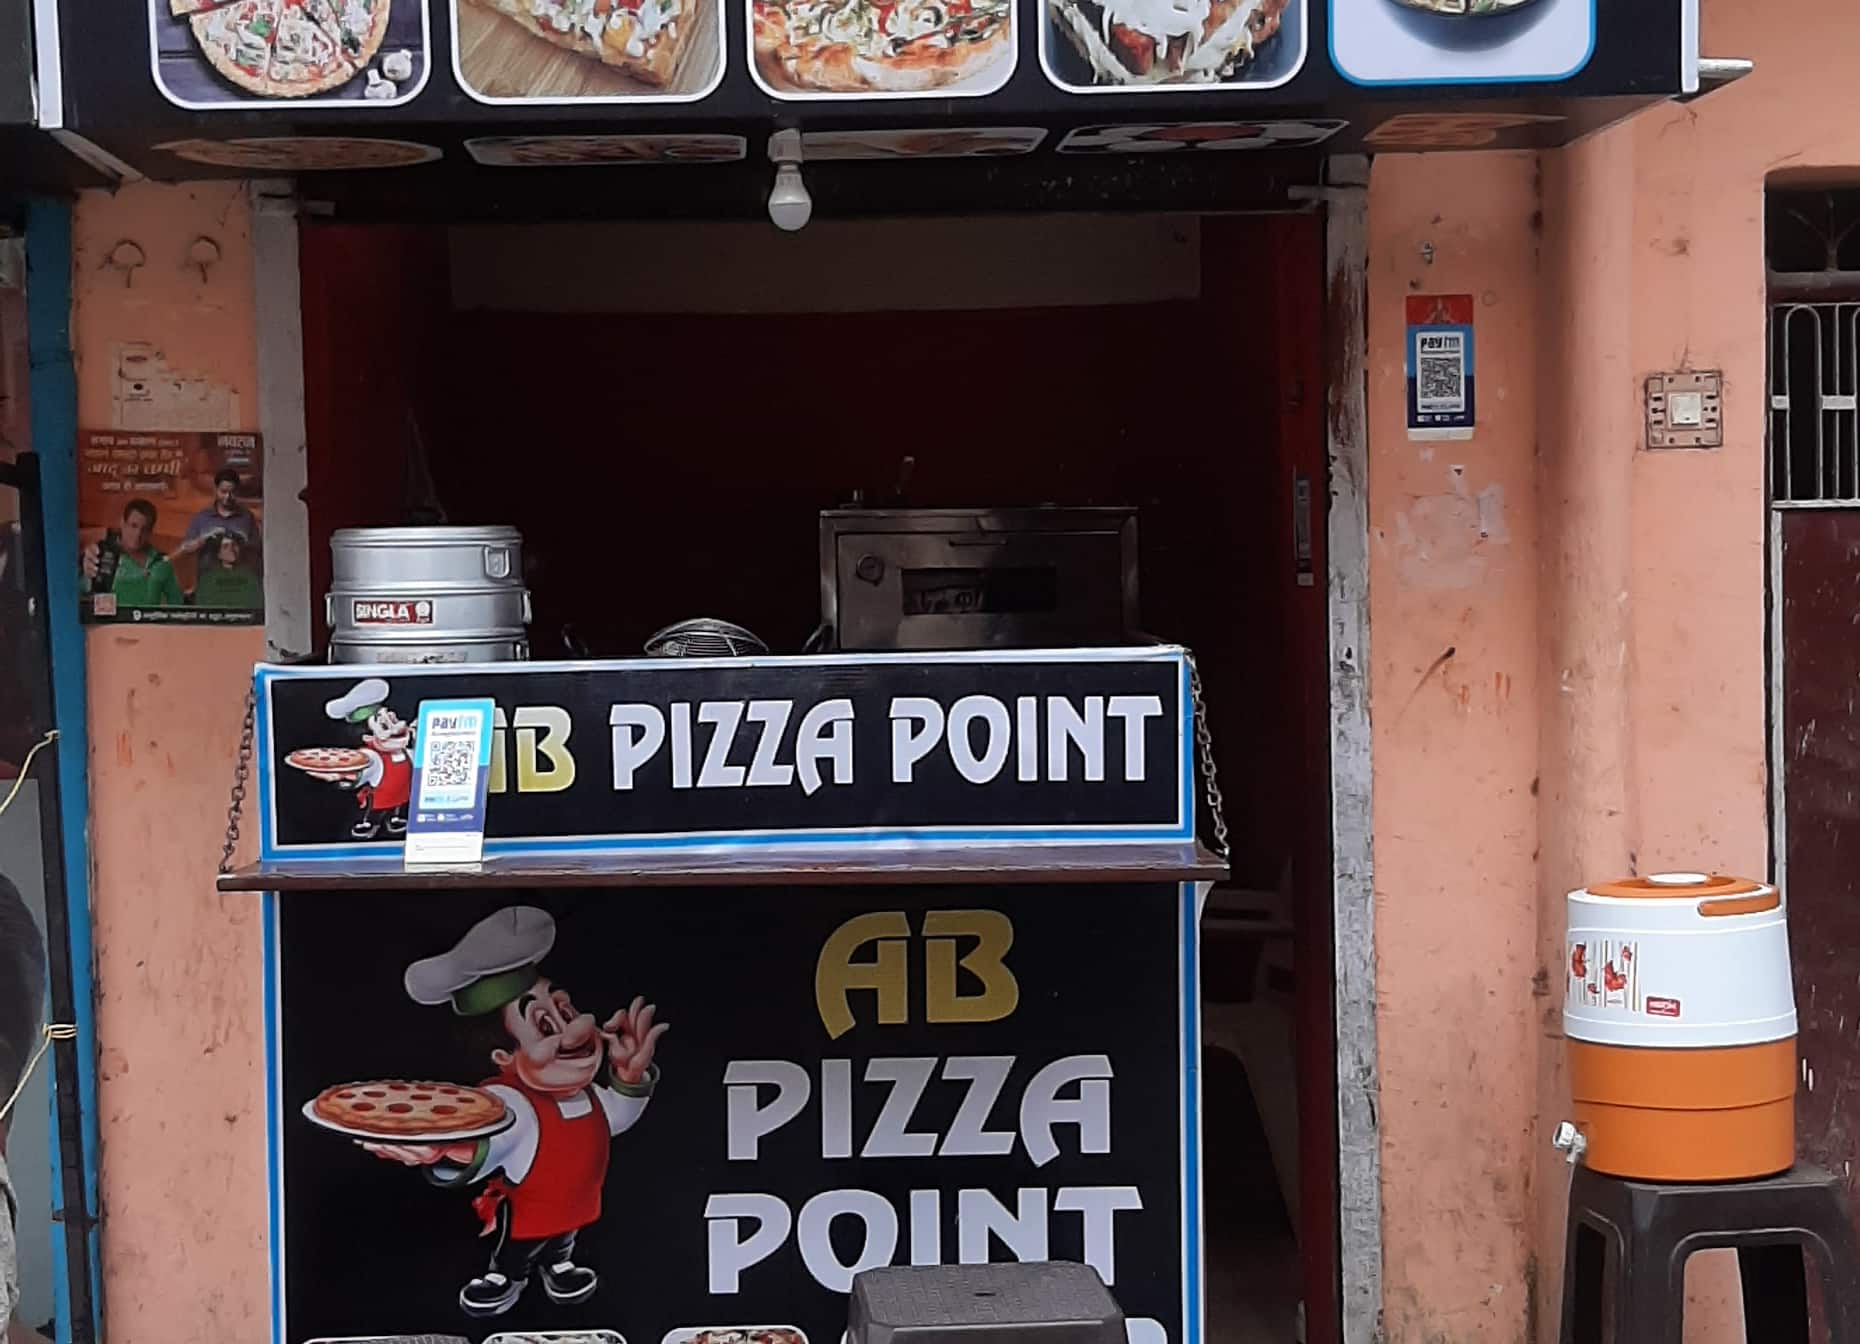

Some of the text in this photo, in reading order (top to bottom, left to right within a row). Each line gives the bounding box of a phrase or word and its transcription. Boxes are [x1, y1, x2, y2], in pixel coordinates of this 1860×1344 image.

[609, 694, 855, 794] PIZZA
[889, 694, 1163, 784] POINT
[814, 909, 1019, 1039] AB
[723, 1054, 1115, 1168] PIZZA
[703, 1186, 1144, 1294] POINT
